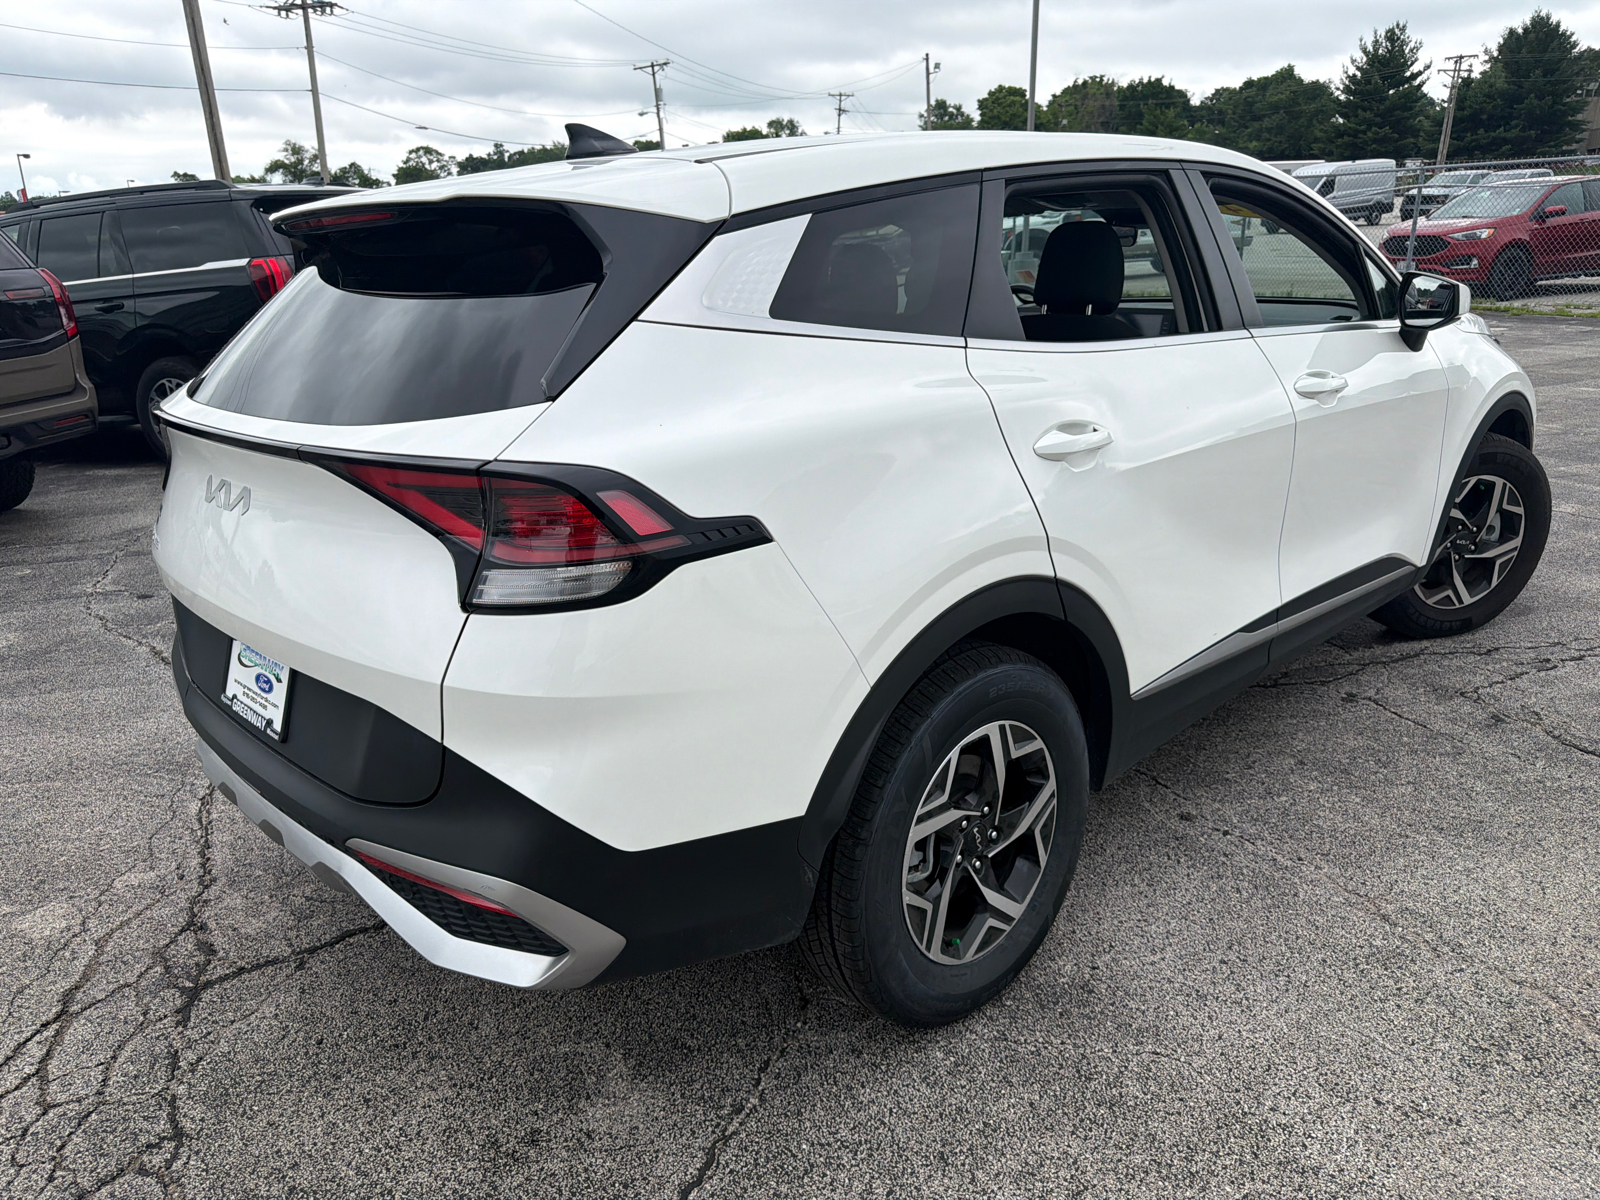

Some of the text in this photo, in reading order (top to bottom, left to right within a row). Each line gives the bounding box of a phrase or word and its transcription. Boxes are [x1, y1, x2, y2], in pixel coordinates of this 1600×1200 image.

[204, 474, 251, 516] KIA
[258, 674, 271, 691] Ford
[232, 698, 267, 731] GREENWAY
